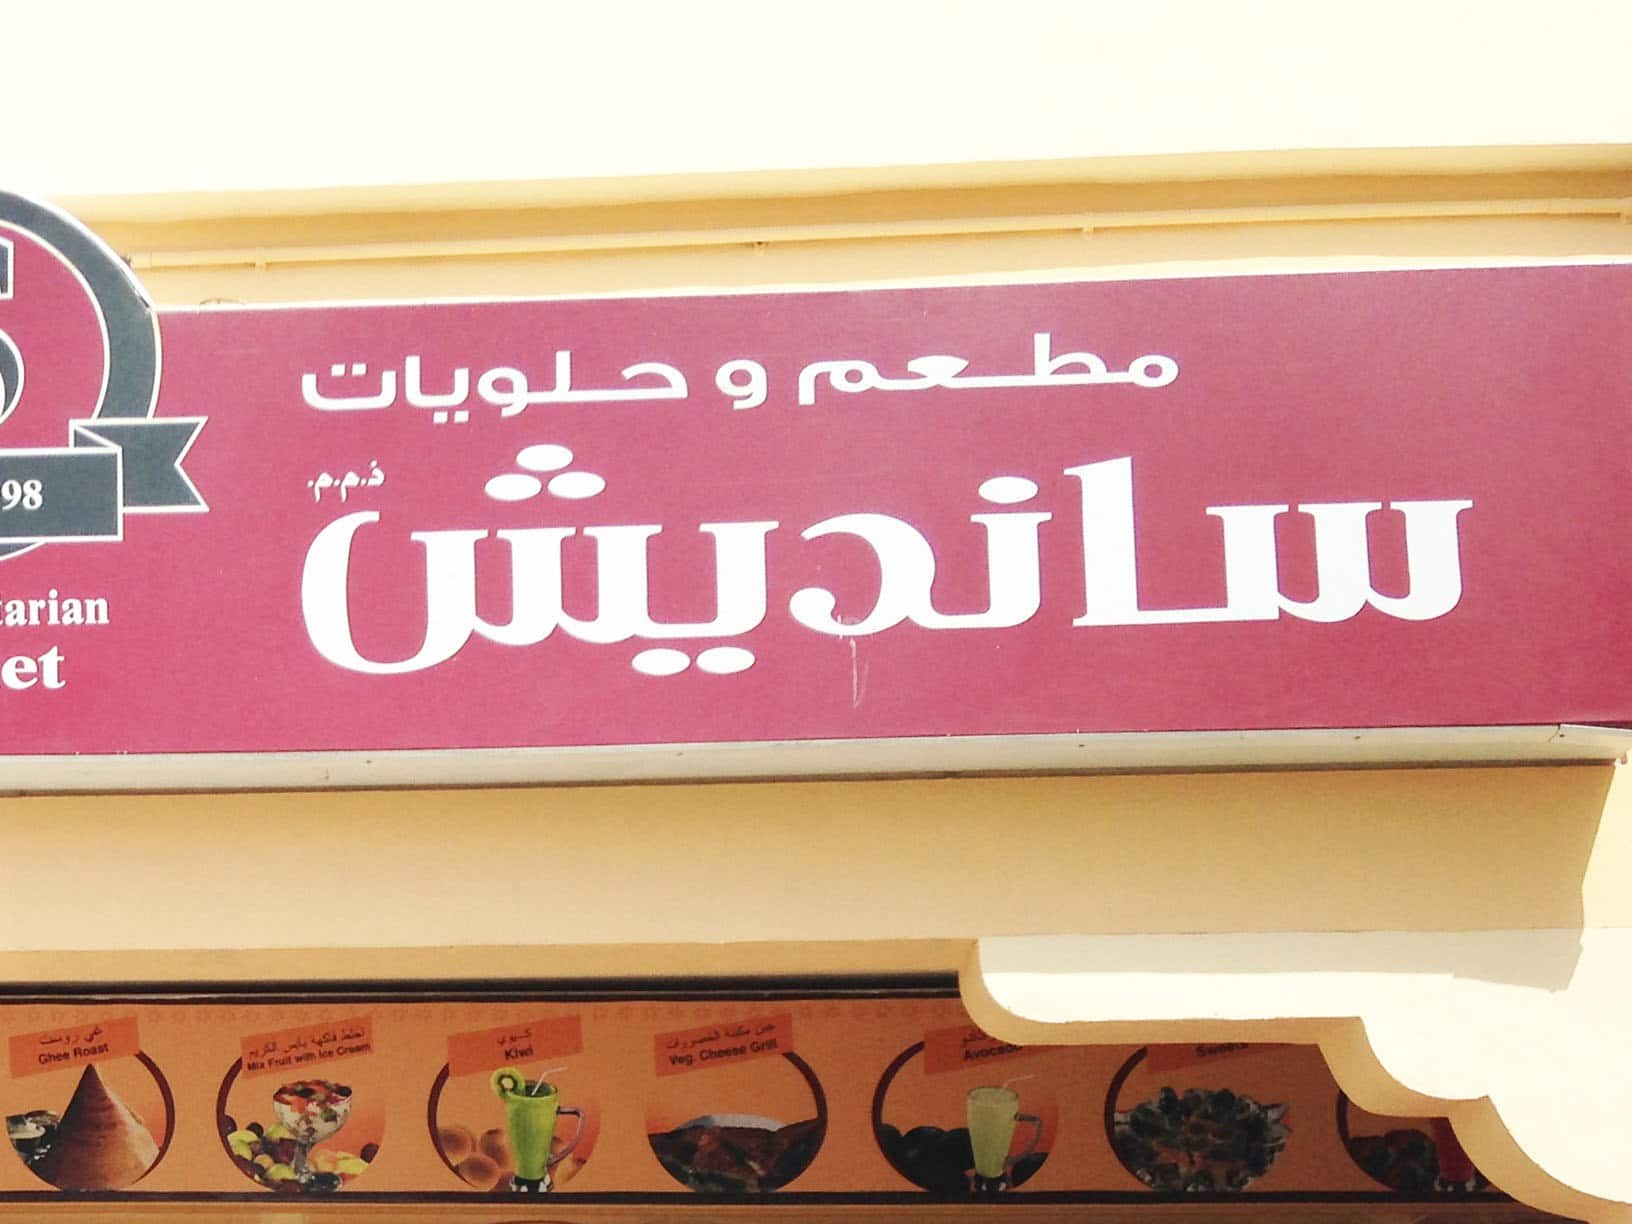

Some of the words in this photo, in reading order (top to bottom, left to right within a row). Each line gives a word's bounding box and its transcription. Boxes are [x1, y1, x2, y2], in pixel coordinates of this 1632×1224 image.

[301, 350, 689, 424] حلويات
[715, 358, 768, 412] و
[799, 331, 1179, 406] مطعم
[300, 443, 1473, 676] سانديش
[38, 1050, 71, 1065] Ghee
[72, 1042, 109, 1058] Roast
[335, 1043, 371, 1057] Cream
[504, 1046, 535, 1061] Kiwi
[699, 1045, 747, 1061] Cheese
[749, 1038, 778, 1053] Grill
